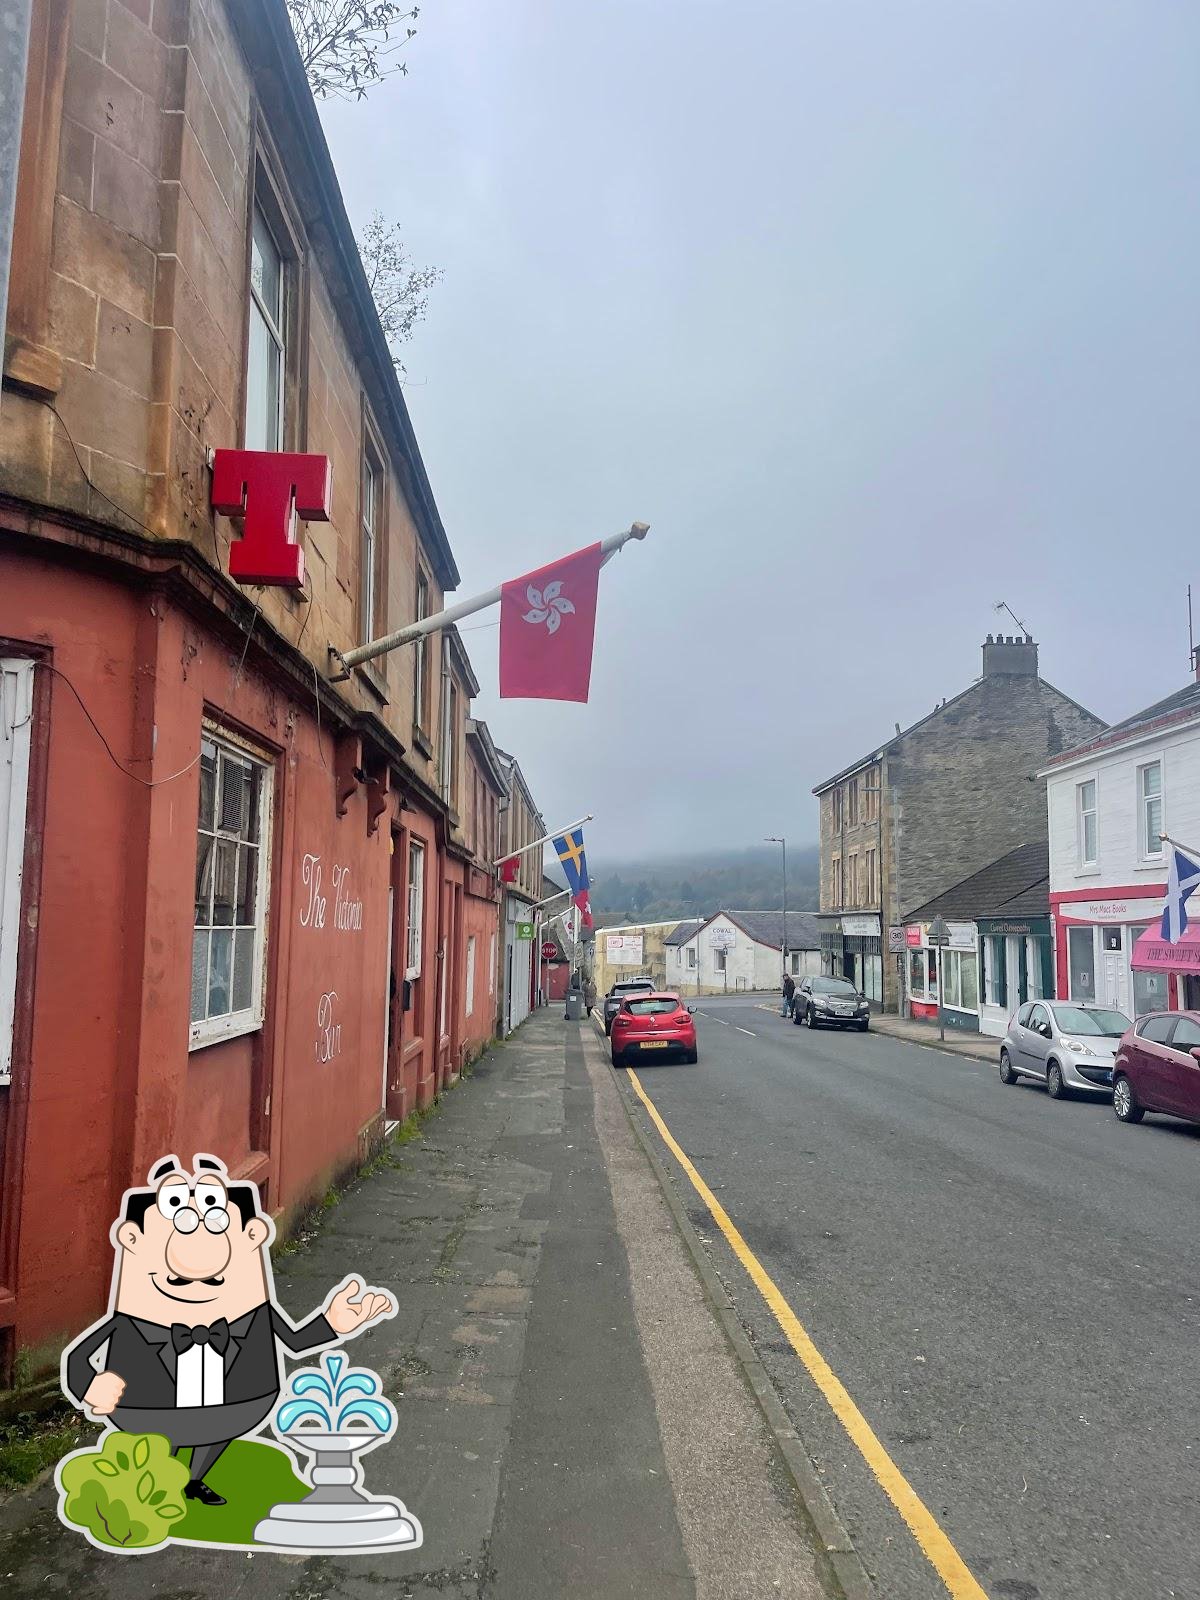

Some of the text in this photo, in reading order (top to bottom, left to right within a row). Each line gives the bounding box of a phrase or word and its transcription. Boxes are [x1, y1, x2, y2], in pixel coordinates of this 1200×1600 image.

[211, 448, 332, 587] T
[300, 853, 362, 930] The Victoria
[1112, 903, 1127, 914] Books
[891, 931, 902, 939] 30
[1163, 948, 1192, 962] SWEET
[317, 991, 341, 1064] Bar
